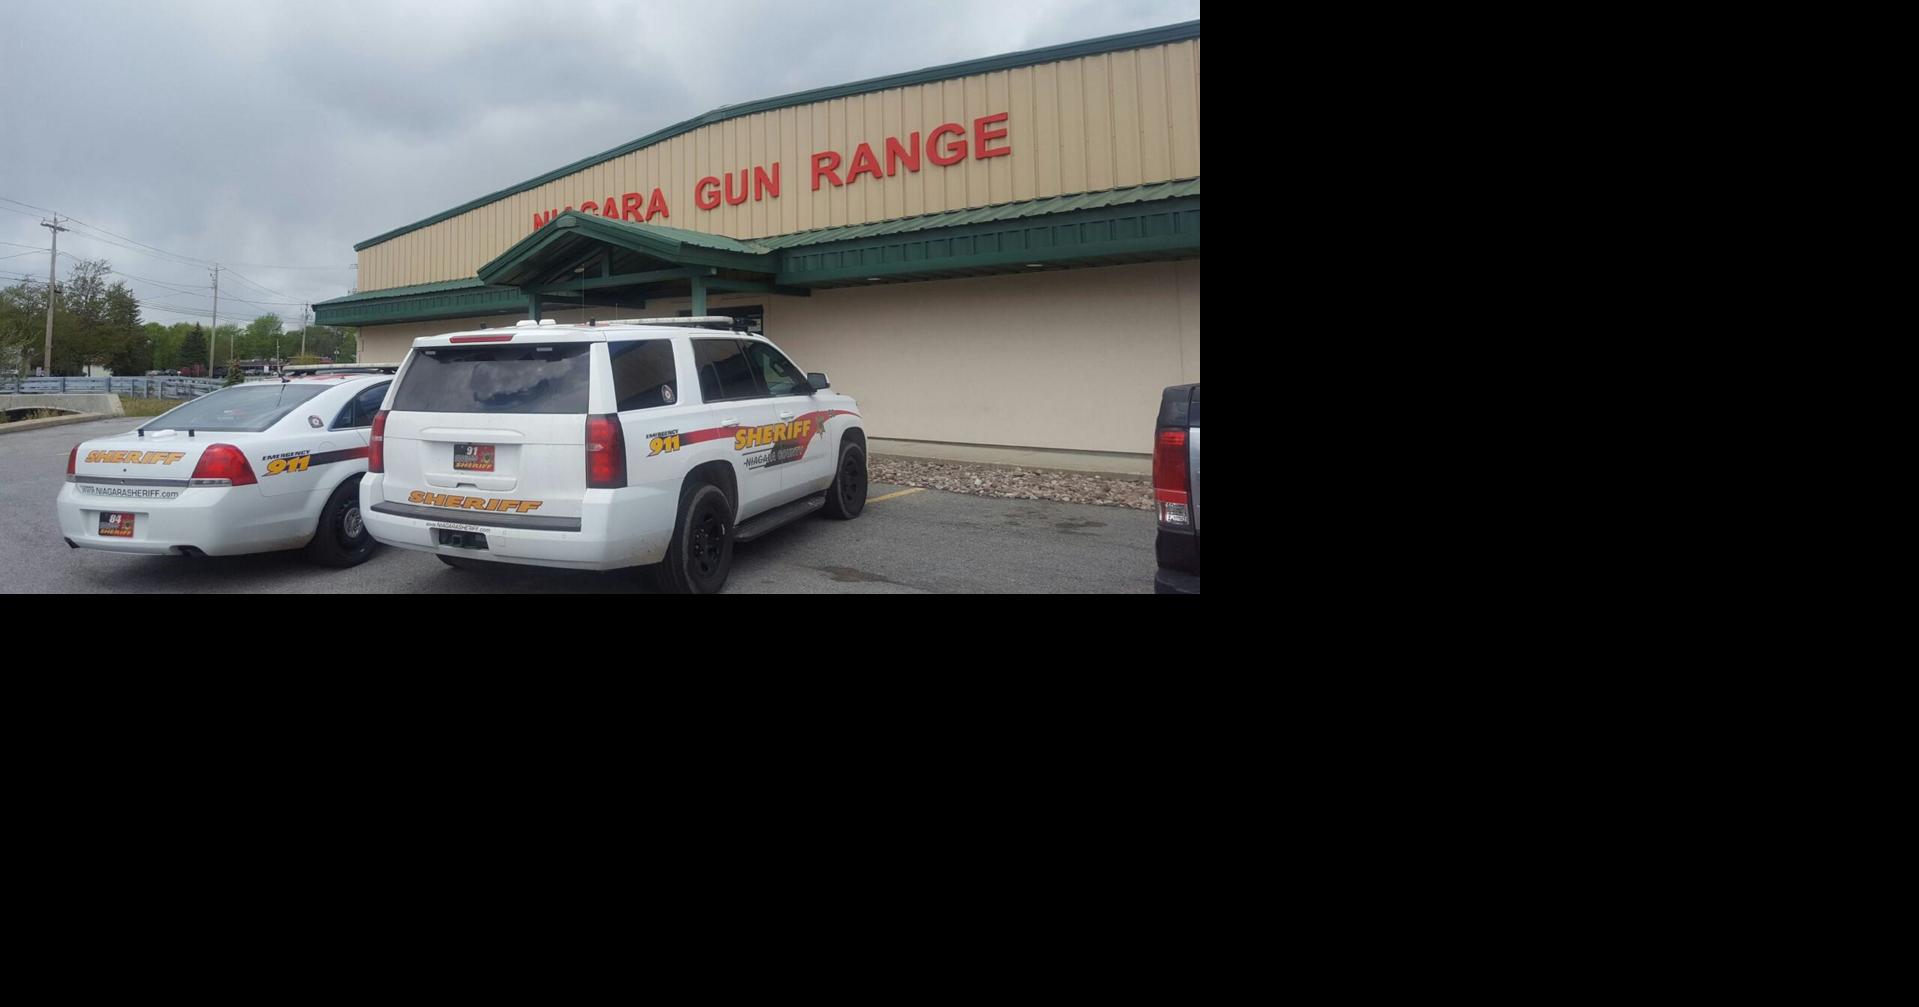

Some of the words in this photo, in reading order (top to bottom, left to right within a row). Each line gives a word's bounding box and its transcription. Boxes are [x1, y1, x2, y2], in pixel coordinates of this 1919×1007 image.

[533, 187, 669, 231] NARA
[694, 162, 780, 210] GUN
[811, 112, 1011, 190] RANGE
[647, 434, 681, 457] 911
[734, 419, 811, 451] SHERIFF
[84, 450, 185, 465] SHERIFF
[262, 450, 310, 460] EMERGENCY
[466, 446, 478, 456] 91
[262, 454, 311, 477] 911
[408, 490, 543, 513] SHERIFF
[109, 514, 122, 524] 84
